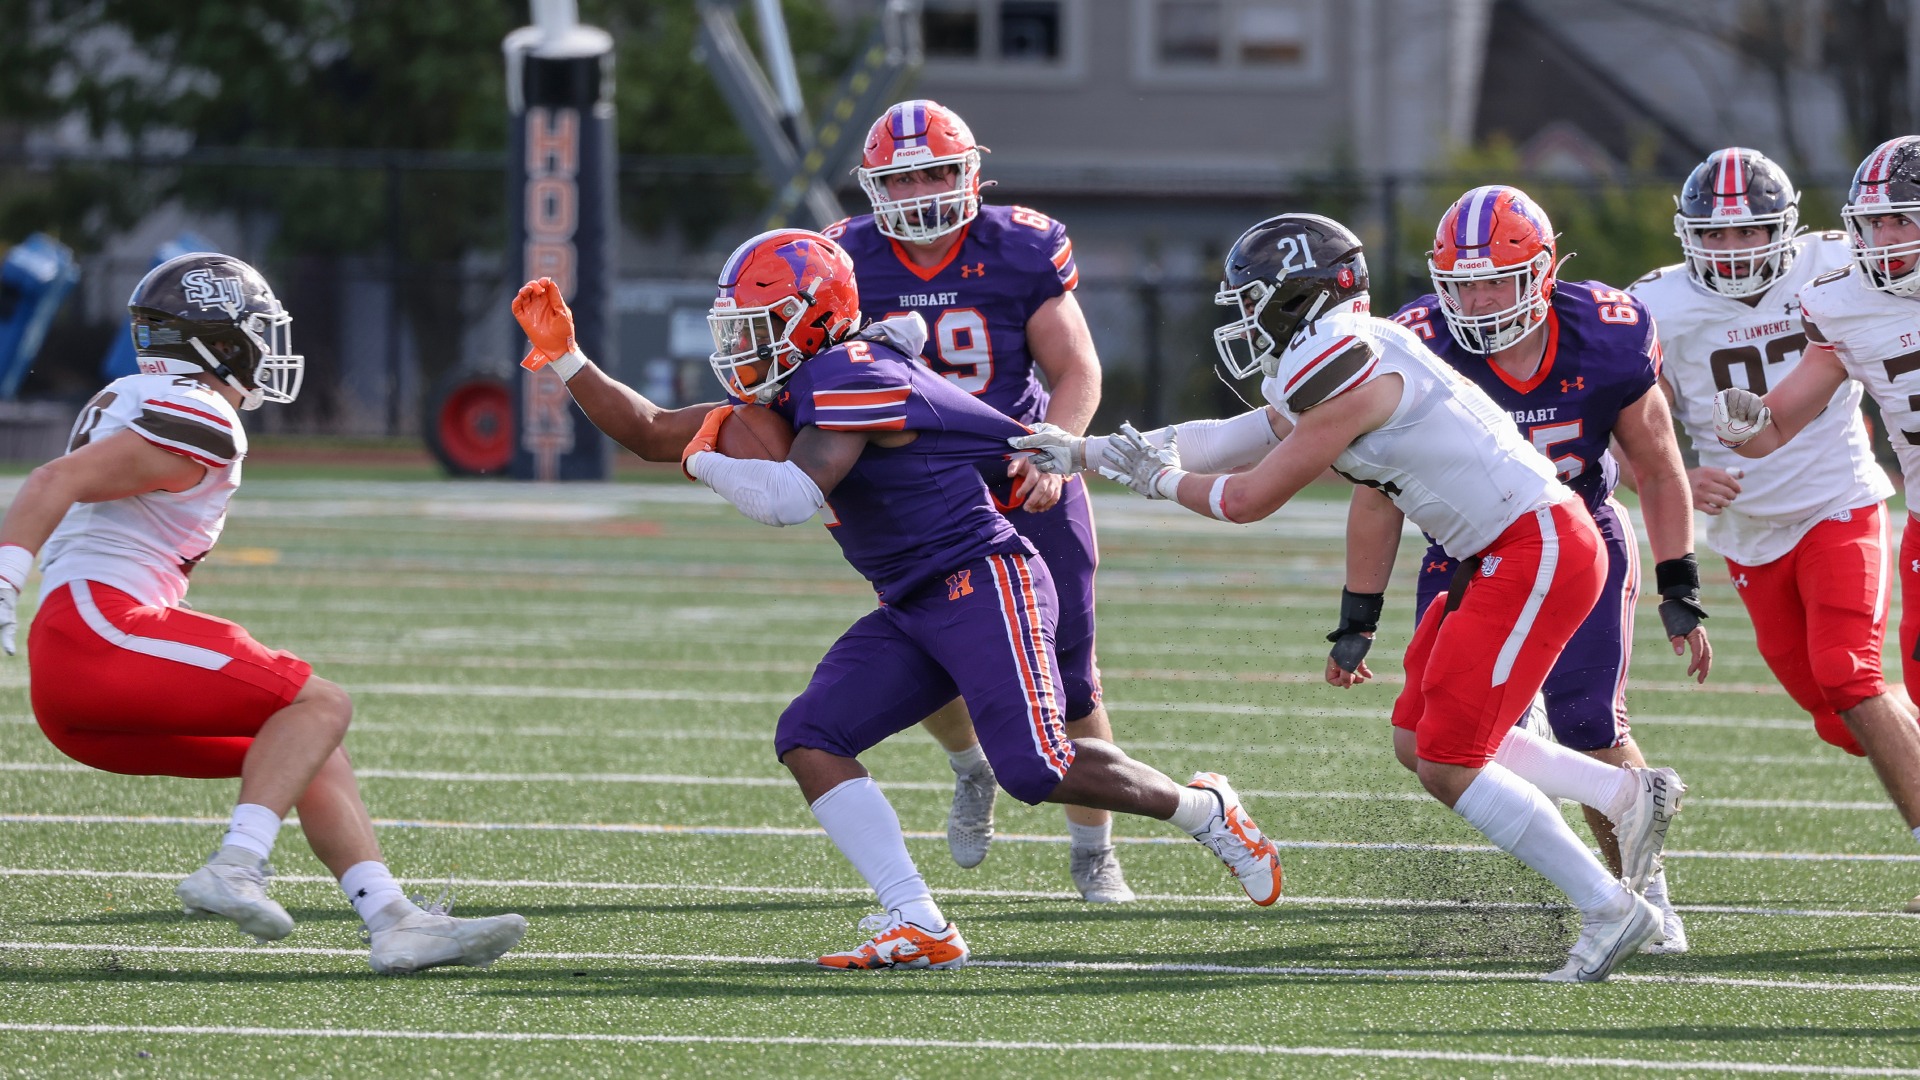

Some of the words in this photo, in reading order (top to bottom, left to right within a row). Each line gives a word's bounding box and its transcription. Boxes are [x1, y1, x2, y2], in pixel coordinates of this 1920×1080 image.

[1720, 207, 1742, 216] SWING
[1277, 233, 1317, 273] 21
[1457, 261, 1488, 269] Riddell
[181, 268, 246, 313] SLU
[525, 107, 580, 482] HOBRT
[899, 292, 958, 307] HOBART
[1590, 288, 1639, 326] 65
[1727, 330, 1742, 343] ST.
[1744, 320, 1790, 340] LAWRENCE
[1900, 333, 1915, 348] ST.
[845, 341, 874, 363] 2
[1510, 408, 1557, 424] BART
[1529, 419, 1584, 484] 5
[1652, 776, 1667, 852] VAPOR
